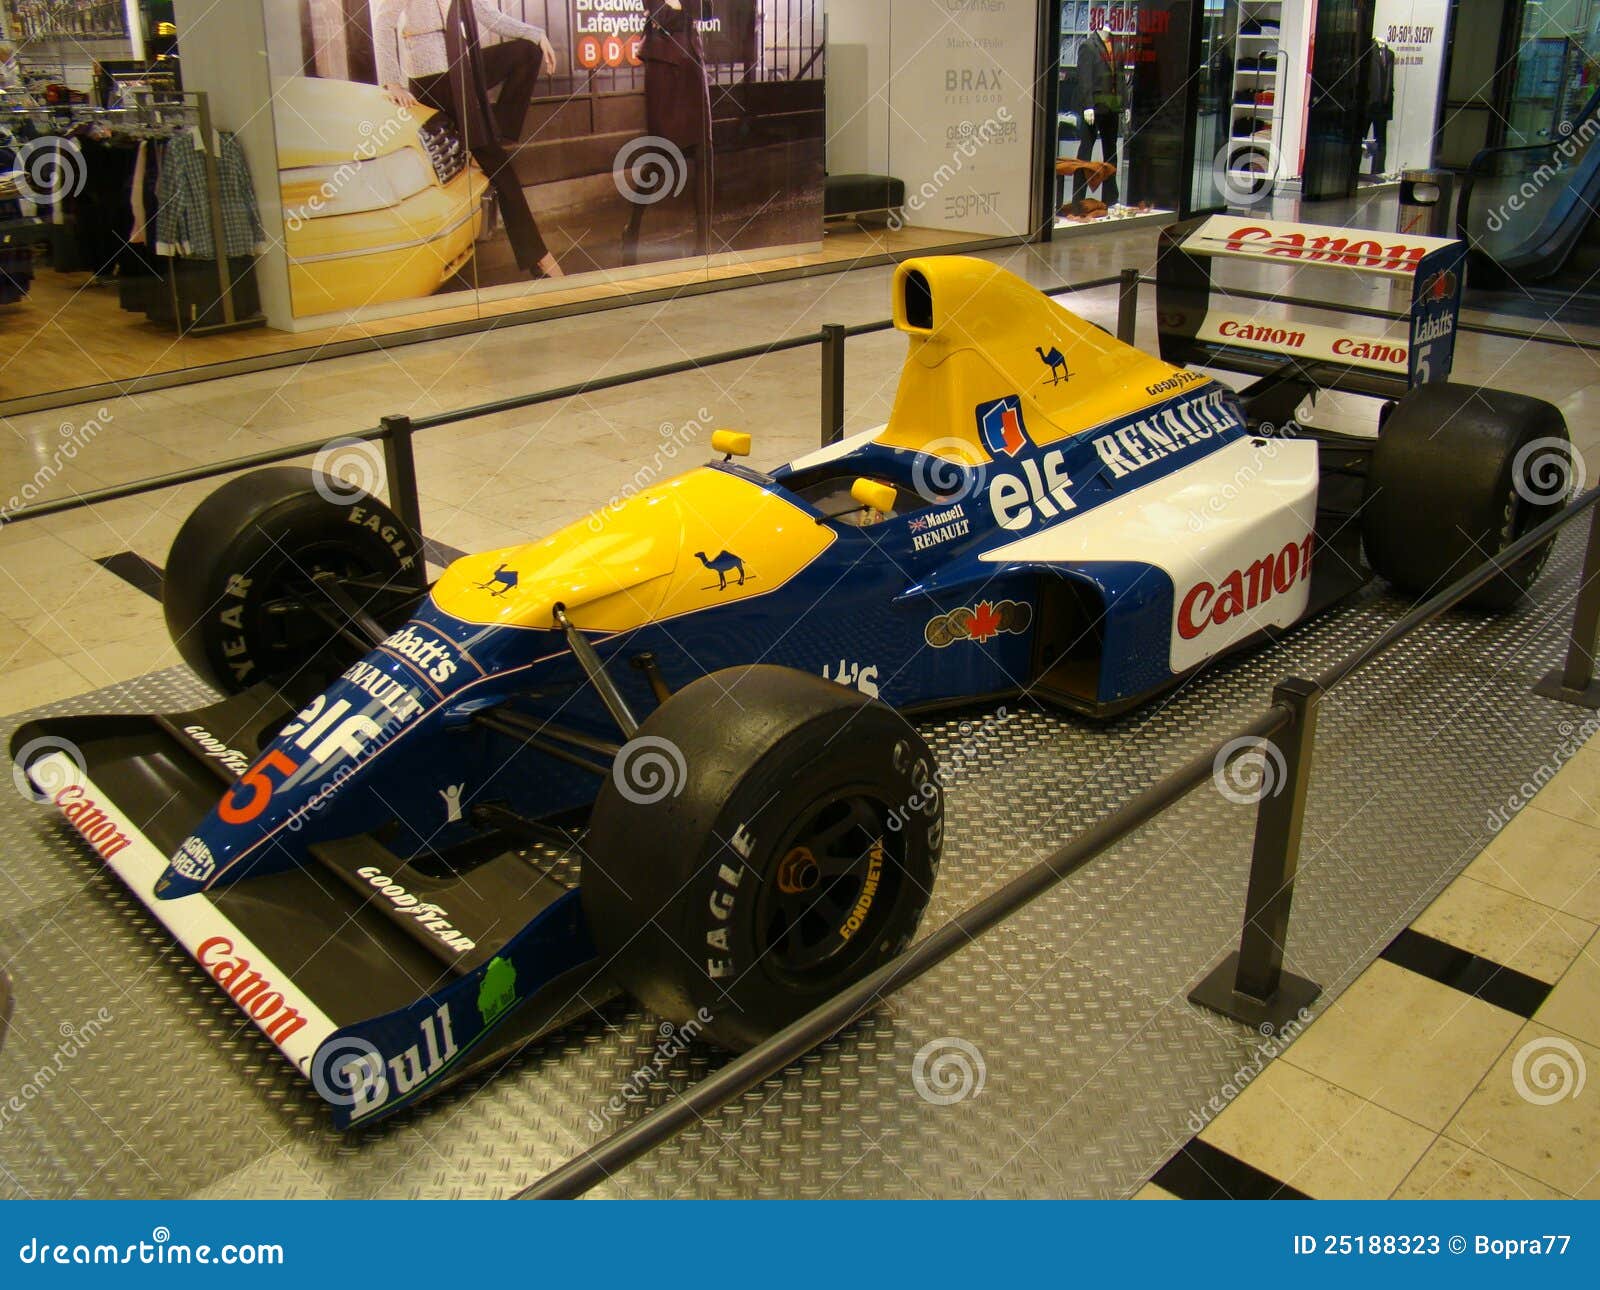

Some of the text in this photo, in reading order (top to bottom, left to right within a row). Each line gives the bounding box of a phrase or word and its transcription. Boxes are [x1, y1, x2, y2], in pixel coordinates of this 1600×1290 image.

[576, 0, 645, 11] Broadwa
[585, 44, 596, 61] B
[608, 43, 619, 60] D
[1387, 25, 1434, 43] 30-50% SLEVY
[945, 69, 1002, 91] BRAX
[944, 191, 1001, 219] ESPRIT
[1225, 226, 1426, 272] Canon
[1219, 321, 1306, 348] Canon
[1332, 338, 1409, 365] Cano
[1145, 372, 1206, 396] GOODYEA
[1415, 344, 1432, 388] 5
[1092, 388, 1240, 479] RENAULT
[925, 504, 964, 528] Mansell
[989, 450, 1077, 530] elf
[348, 506, 415, 571] EAGLE
[912, 519, 970, 551] RENAULT
[220, 573, 254, 681] YEAR
[381, 625, 458, 683] abatt's
[341, 661, 425, 723] ENAULT
[217, 749, 299, 825] 5
[55, 785, 132, 859] Canon
[356, 866, 476, 952] GOODYEAR
[706, 824, 757, 979] EAGLE
[197, 936, 308, 1046] Canon
[341, 1002, 459, 1120] Bull
